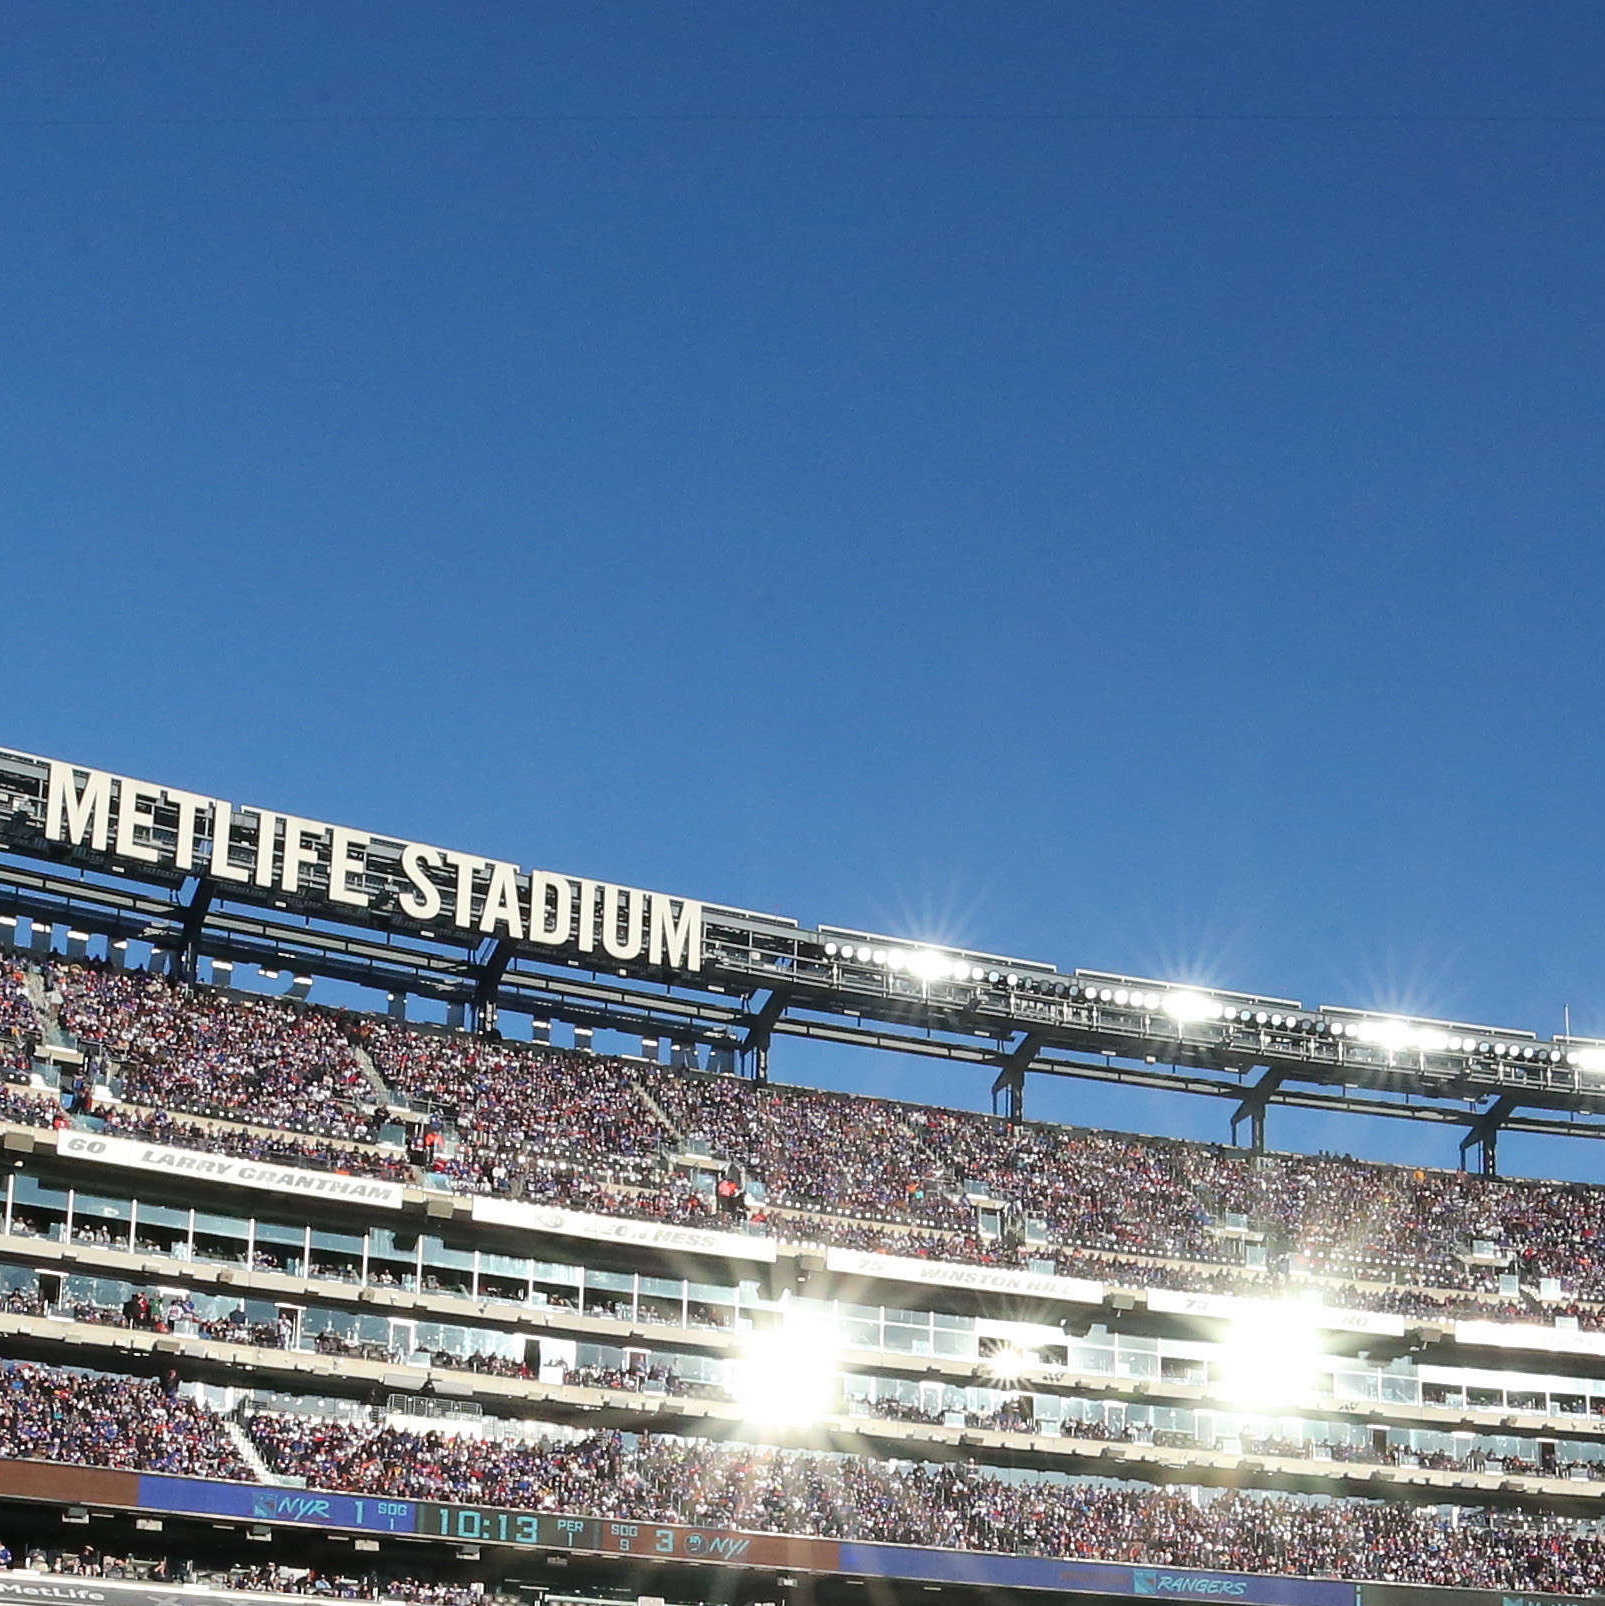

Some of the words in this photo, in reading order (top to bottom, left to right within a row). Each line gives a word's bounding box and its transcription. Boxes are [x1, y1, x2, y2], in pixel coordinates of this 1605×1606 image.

[43, 760, 371, 908] METLIFE
[399, 842, 701, 972] STADIUM
[67, 1137, 107, 1154] 60
[141, 1149, 234, 1175] LARRY
[238, 1166, 392, 1201] GRANTHAM
[653, 1229, 718, 1248] HESS
[856, 1259, 884, 1272] 75
[920, 1266, 1024, 1290] WINSTON
[1025, 1281, 1075, 1295] HILL
[1184, 1298, 1209, 1312] 73
[277, 1499, 332, 1520] NYR
[355, 1501, 364, 1524] 1
[378, 1503, 407, 1516] SOG
[439, 1509, 539, 1543] 10:13
[558, 1520, 583, 1533] PER
[611, 1524, 638, 1537] SOG
[620, 1539, 630, 1550] 9
[655, 1529, 674, 1553] 3
[709, 1536, 751, 1560] NYI
[1157, 1576, 1248, 1595] RANGERS
